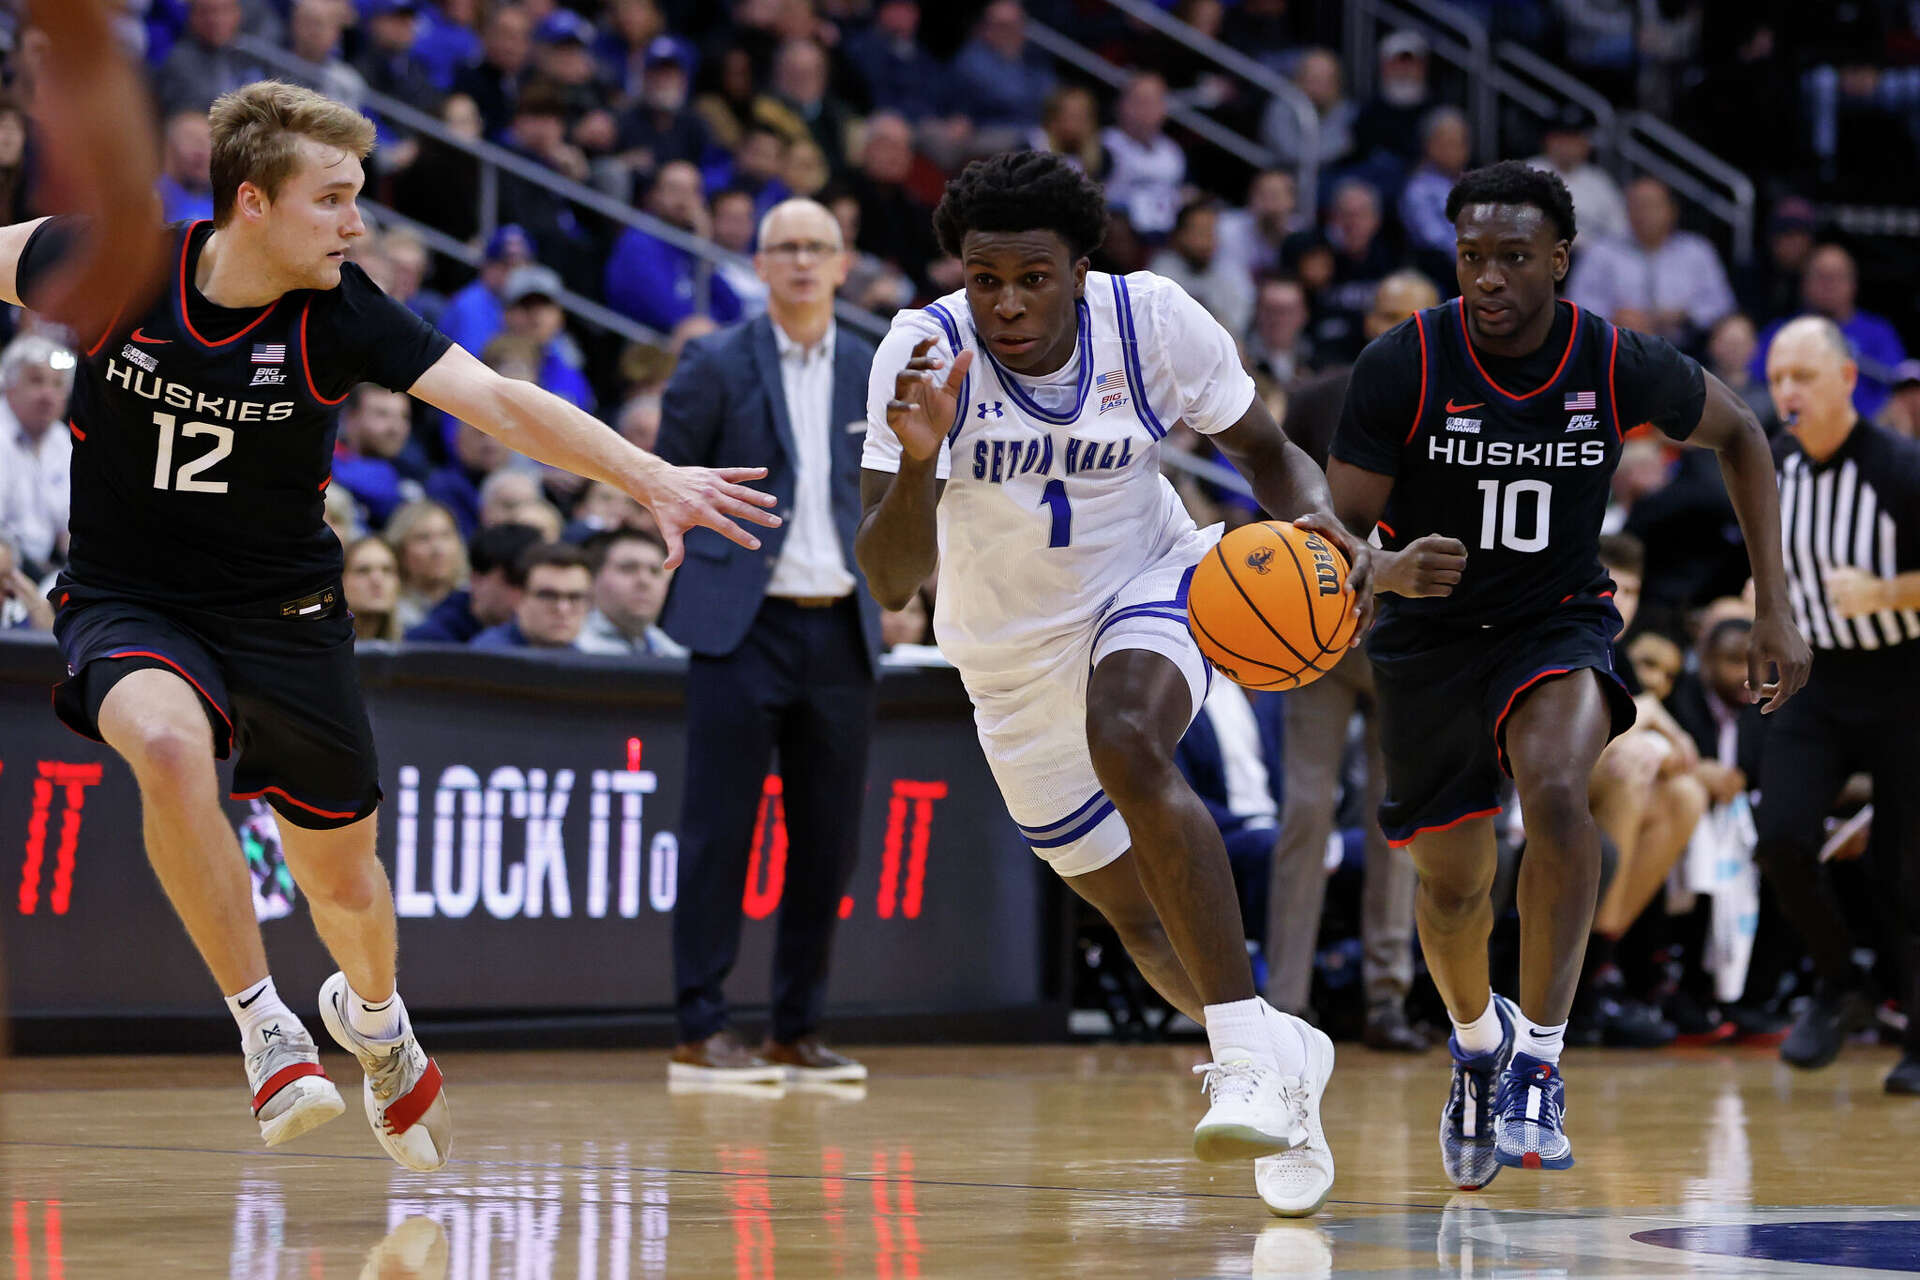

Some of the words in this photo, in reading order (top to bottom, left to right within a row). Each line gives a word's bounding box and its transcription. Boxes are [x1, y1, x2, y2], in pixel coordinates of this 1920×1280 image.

[105, 358, 295, 421] HUSKIES
[252, 375, 288, 383] EAST
[255, 367, 280, 376] BIG
[1100, 398, 1129, 411] EAST
[1102, 392, 1122, 404] BIG
[1570, 414, 1594, 423] BIG
[1445, 424, 1480, 434] CHANGE
[1567, 420, 1600, 430] EAST
[152, 411, 235, 494] 12
[973, 432, 1054, 484] SETON
[1065, 436, 1133, 476] HALL
[1428, 435, 1605, 467] HUSKIES
[1039, 478, 1073, 549] 1
[1477, 479, 1553, 553] 10
[17, 760, 103, 915] IT
[395, 764, 576, 920] LOCK
[587, 769, 658, 919] IT
[876, 779, 949, 920] IT
